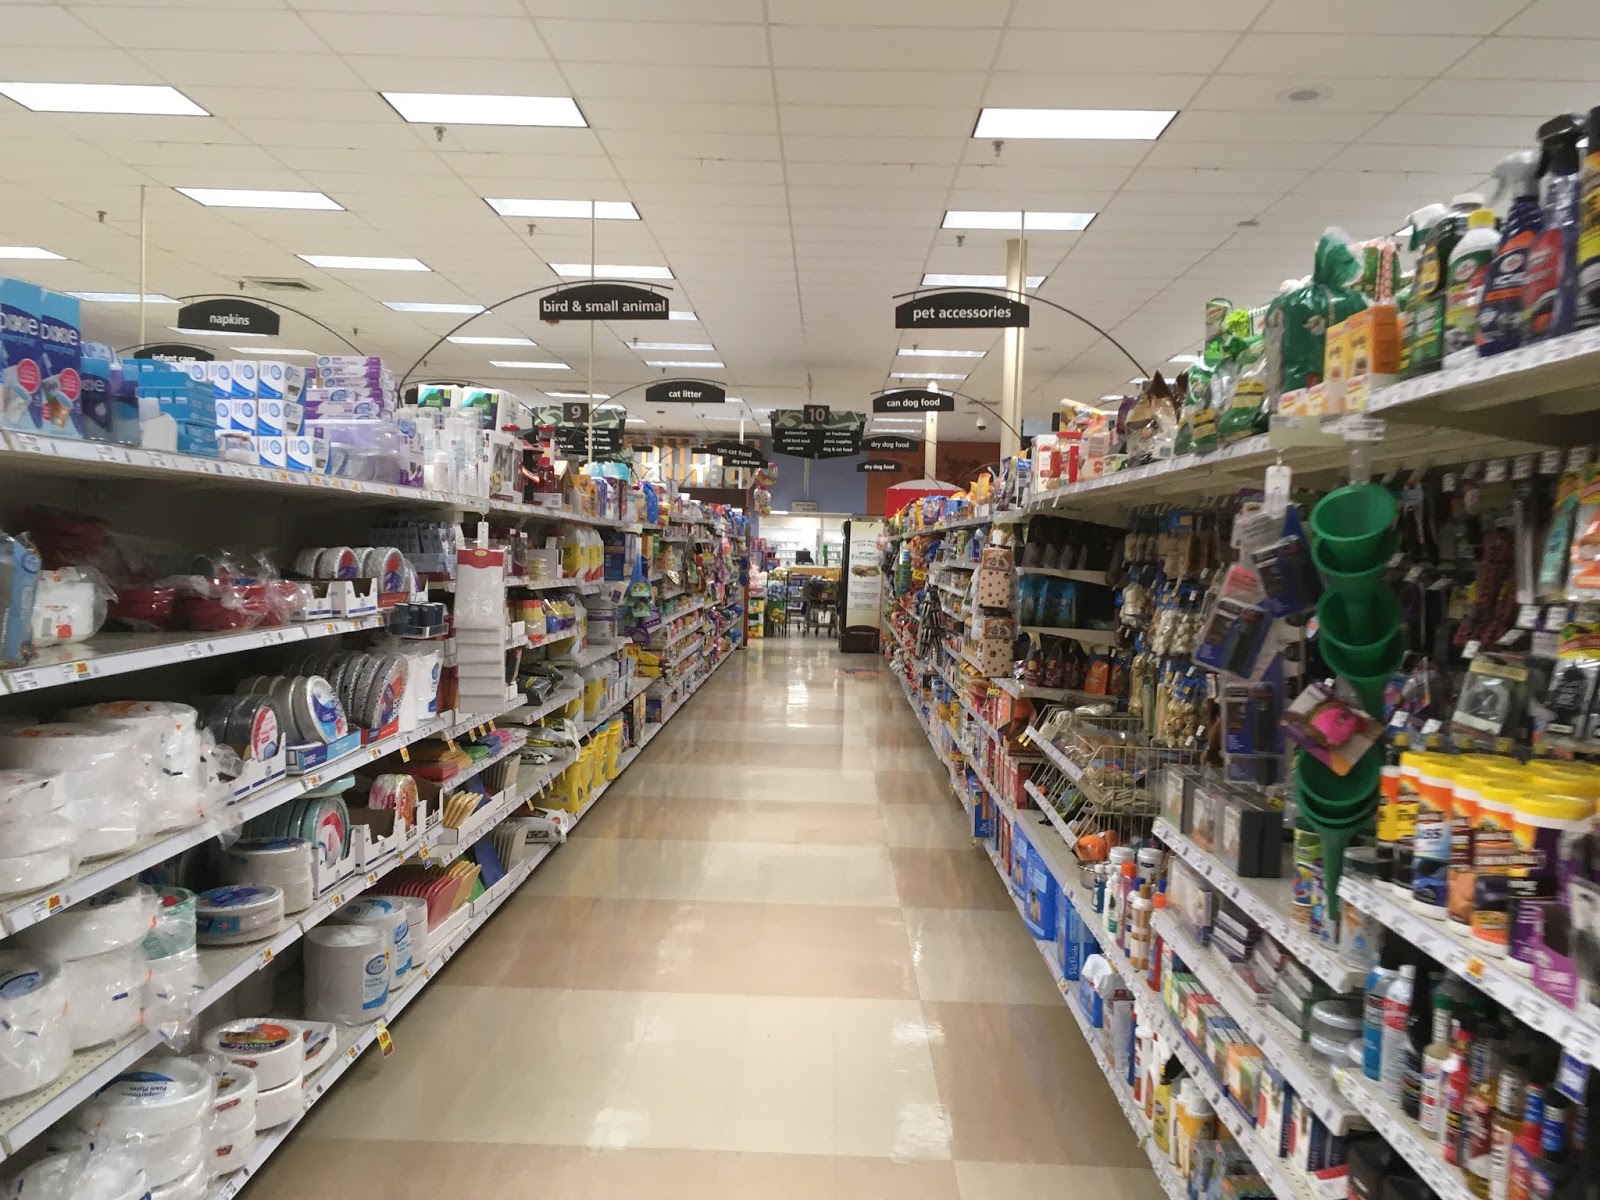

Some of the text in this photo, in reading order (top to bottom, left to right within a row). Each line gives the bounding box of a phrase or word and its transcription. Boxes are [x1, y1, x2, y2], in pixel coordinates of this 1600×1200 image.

[543, 300, 666, 312] bird & small animal
[913, 306, 1012, 321] pet accessories
[209, 313, 250, 326] napkins
[152, 353, 178, 362] infant
[668, 389, 703, 398] cat litter
[886, 397, 941, 408] can dog food
[571, 405, 582, 419] 9
[808, 407, 827, 422] 10
[870, 440, 910, 449] dry dog food
[738, 450, 753, 458] food
[883, 462, 895, 470] food
